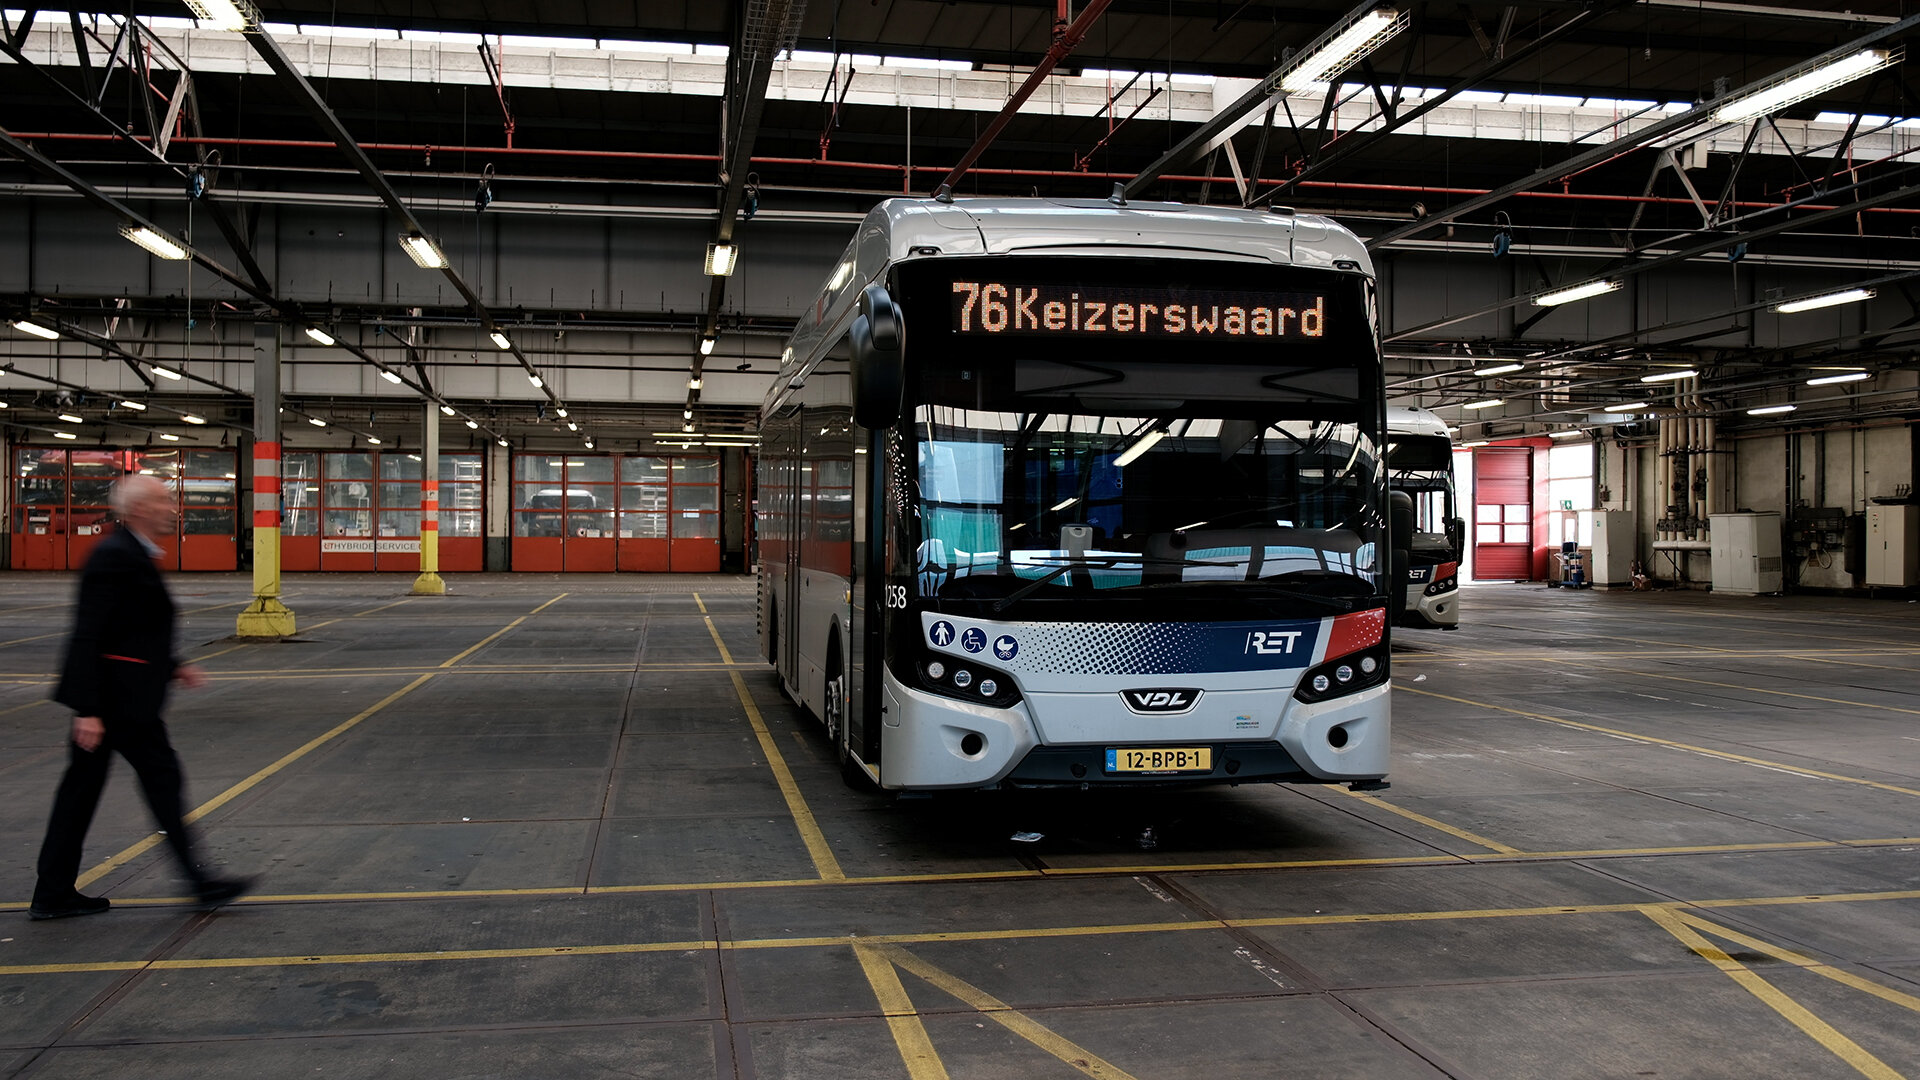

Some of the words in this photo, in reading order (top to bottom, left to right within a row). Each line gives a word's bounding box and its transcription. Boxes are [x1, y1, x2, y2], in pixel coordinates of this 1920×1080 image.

[952, 282, 1008, 332] 76
[1015, 287, 1323, 337] Keizerswaard
[376, 542, 415, 550] SERVICE
[1409, 569, 1427, 579] RET
[885, 584, 907, 609] 1258
[1251, 631, 1302, 655] RET
[1134, 692, 1187, 707] VDL
[1126, 751, 1200, 769] 12-BPB-1
